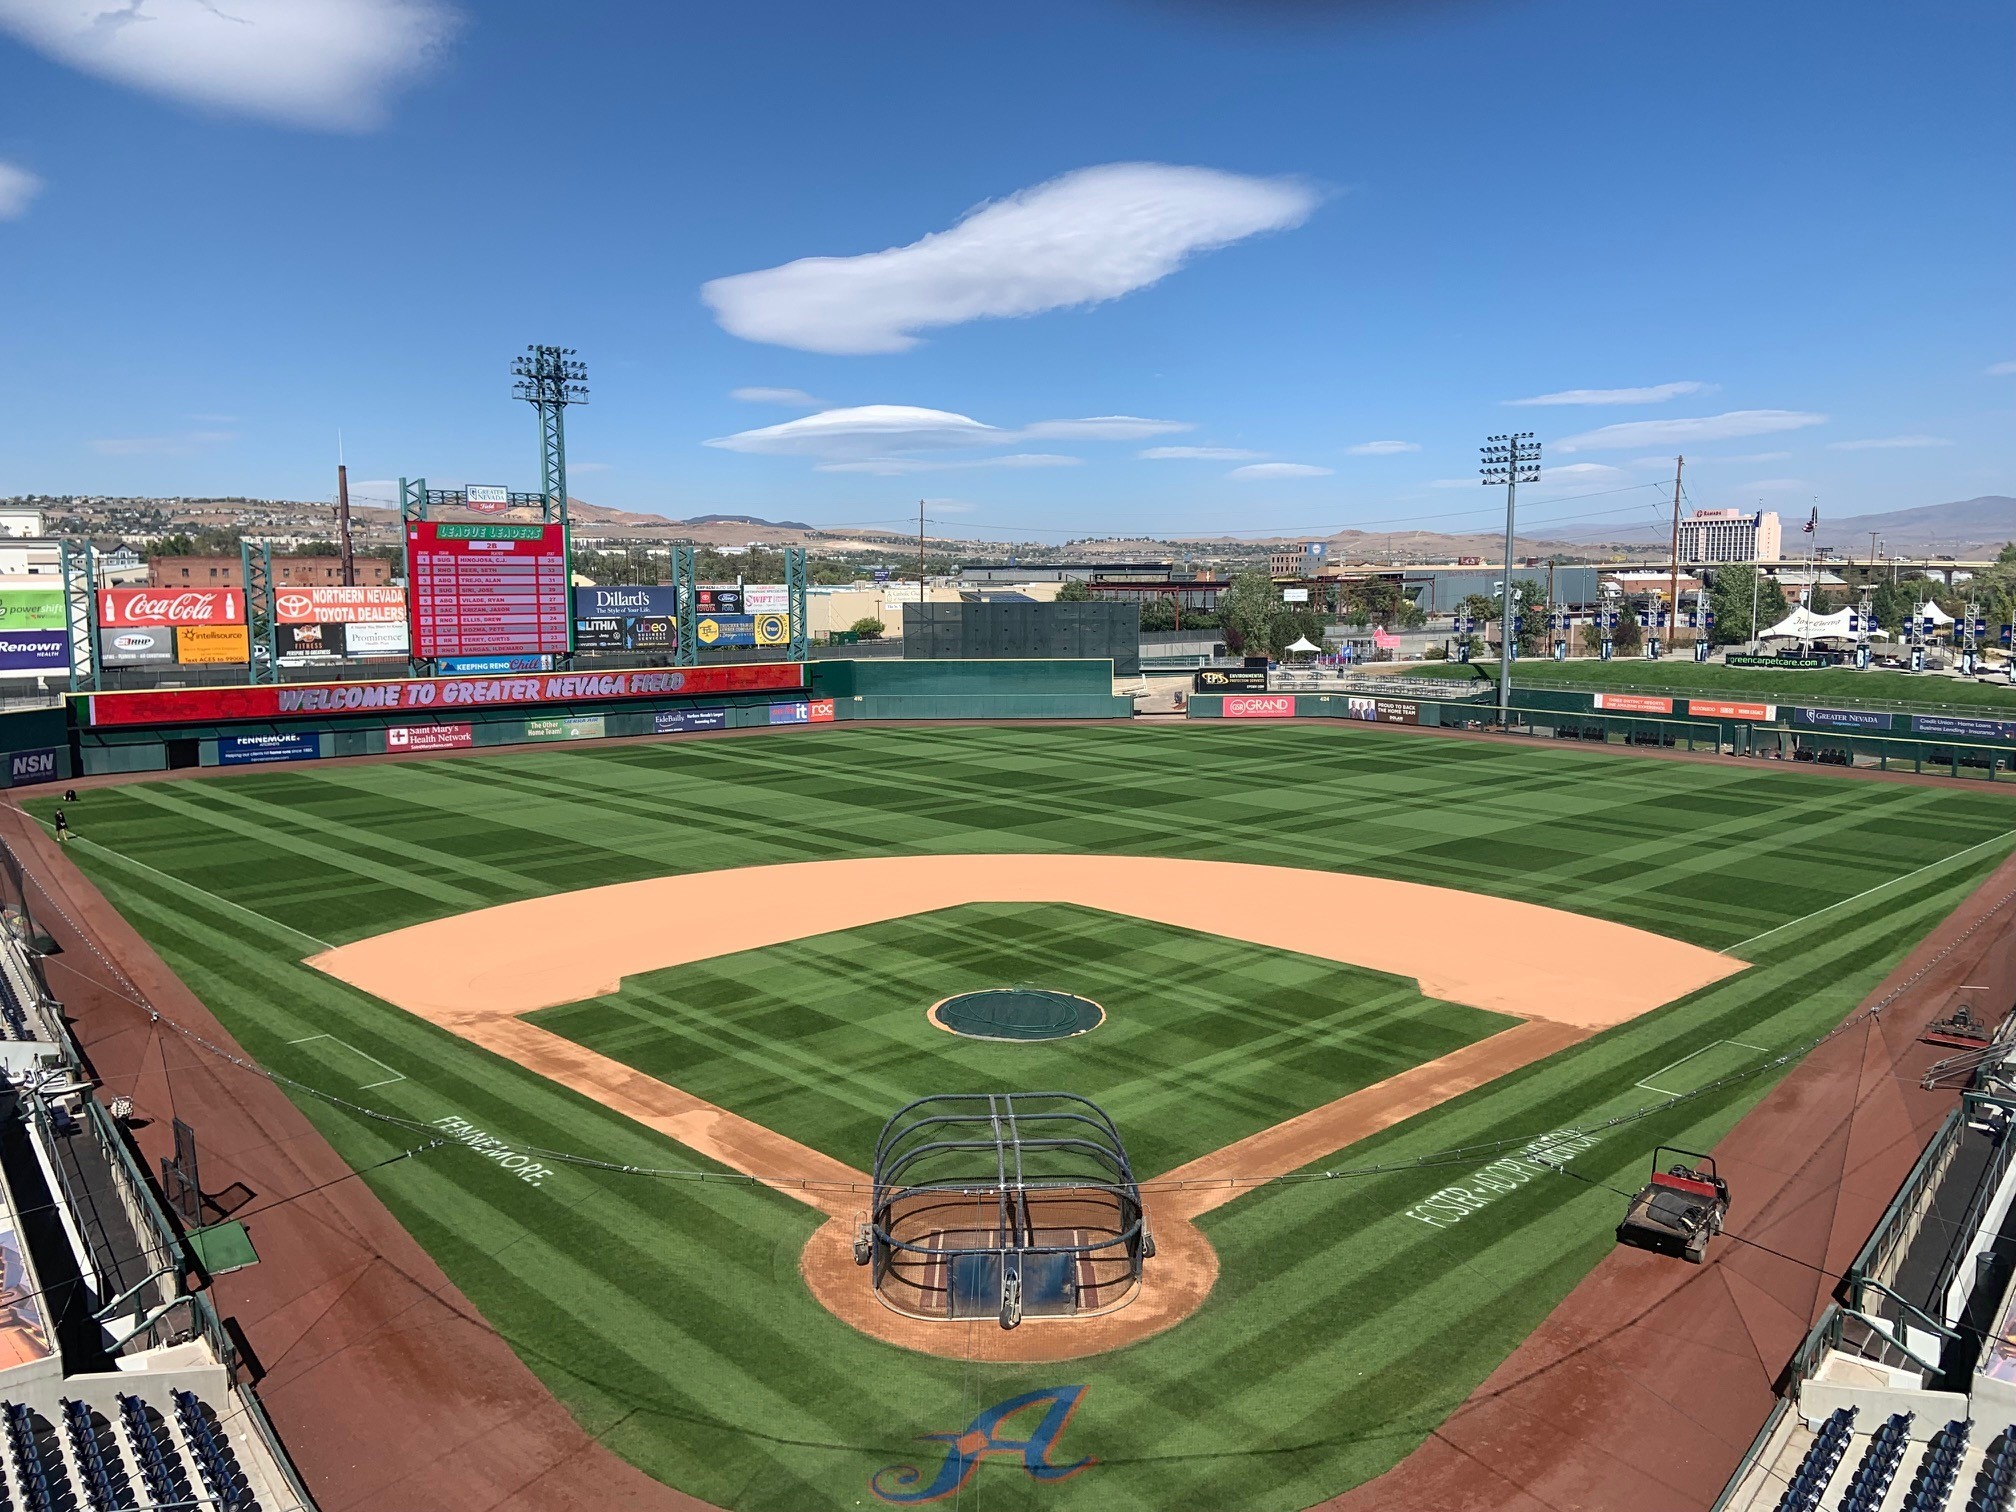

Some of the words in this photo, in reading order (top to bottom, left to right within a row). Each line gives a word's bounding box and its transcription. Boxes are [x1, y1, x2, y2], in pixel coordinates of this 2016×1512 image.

[441, 527, 486, 538] LEAGUE
[490, 527, 541, 539] LEADERS
[312, 589, 364, 604] NORTHERN
[367, 589, 403, 603] NEVADA
[596, 591, 650, 607] Dillard's
[745, 595, 773, 607] SWIFT
[10, 603, 64, 615] powershift
[125, 593, 217, 620] Coca-Cola
[313, 607, 355, 622] TOYOTA
[585, 621, 618, 631] LITHIA
[636, 620, 667, 633] ubeo
[195, 631, 242, 639] intellisource
[352, 633, 402, 642] Prominence
[0, 641, 61, 652] Renown
[509, 658, 541, 670] Chill
[1648, 642, 1654, 659] L
[1696, 643, 1703, 661] Y
[1856, 649, 1864, 668] B
[1912, 651, 1920, 671] E
[1962, 653, 1970, 675] R
[1730, 656, 1818, 667] greencarpetcare.com
[457, 663, 489, 671] KEEPING
[489, 662, 510, 670] RENO
[279, 684, 401, 712] WELCOME
[406, 683, 437, 706] TO
[442, 679, 541, 704] GREATER
[630, 672, 684, 693] FIELD
[796, 703, 807, 719] it
[811, 704, 833, 714] roc
[1232, 703, 1244, 711] GSR
[1246, 699, 1288, 710] GRAND
[655, 715, 684, 723] EideBailly
[1816, 712, 1847, 721] GREATER
[1849, 714, 1878, 723] NEVADA
[409, 726, 430, 735] Saint
[431, 725, 459, 734] Mary's
[1942, 726, 1965, 734] Lending
[409, 736, 435, 744] Health
[437, 732, 472, 742] Network
[13, 753, 54, 775] NSN
[1405, 1186, 1495, 1229] FOSTER
[1472, 1158, 1545, 1194] ADOPT
[867, 1383, 1100, 1507] A
